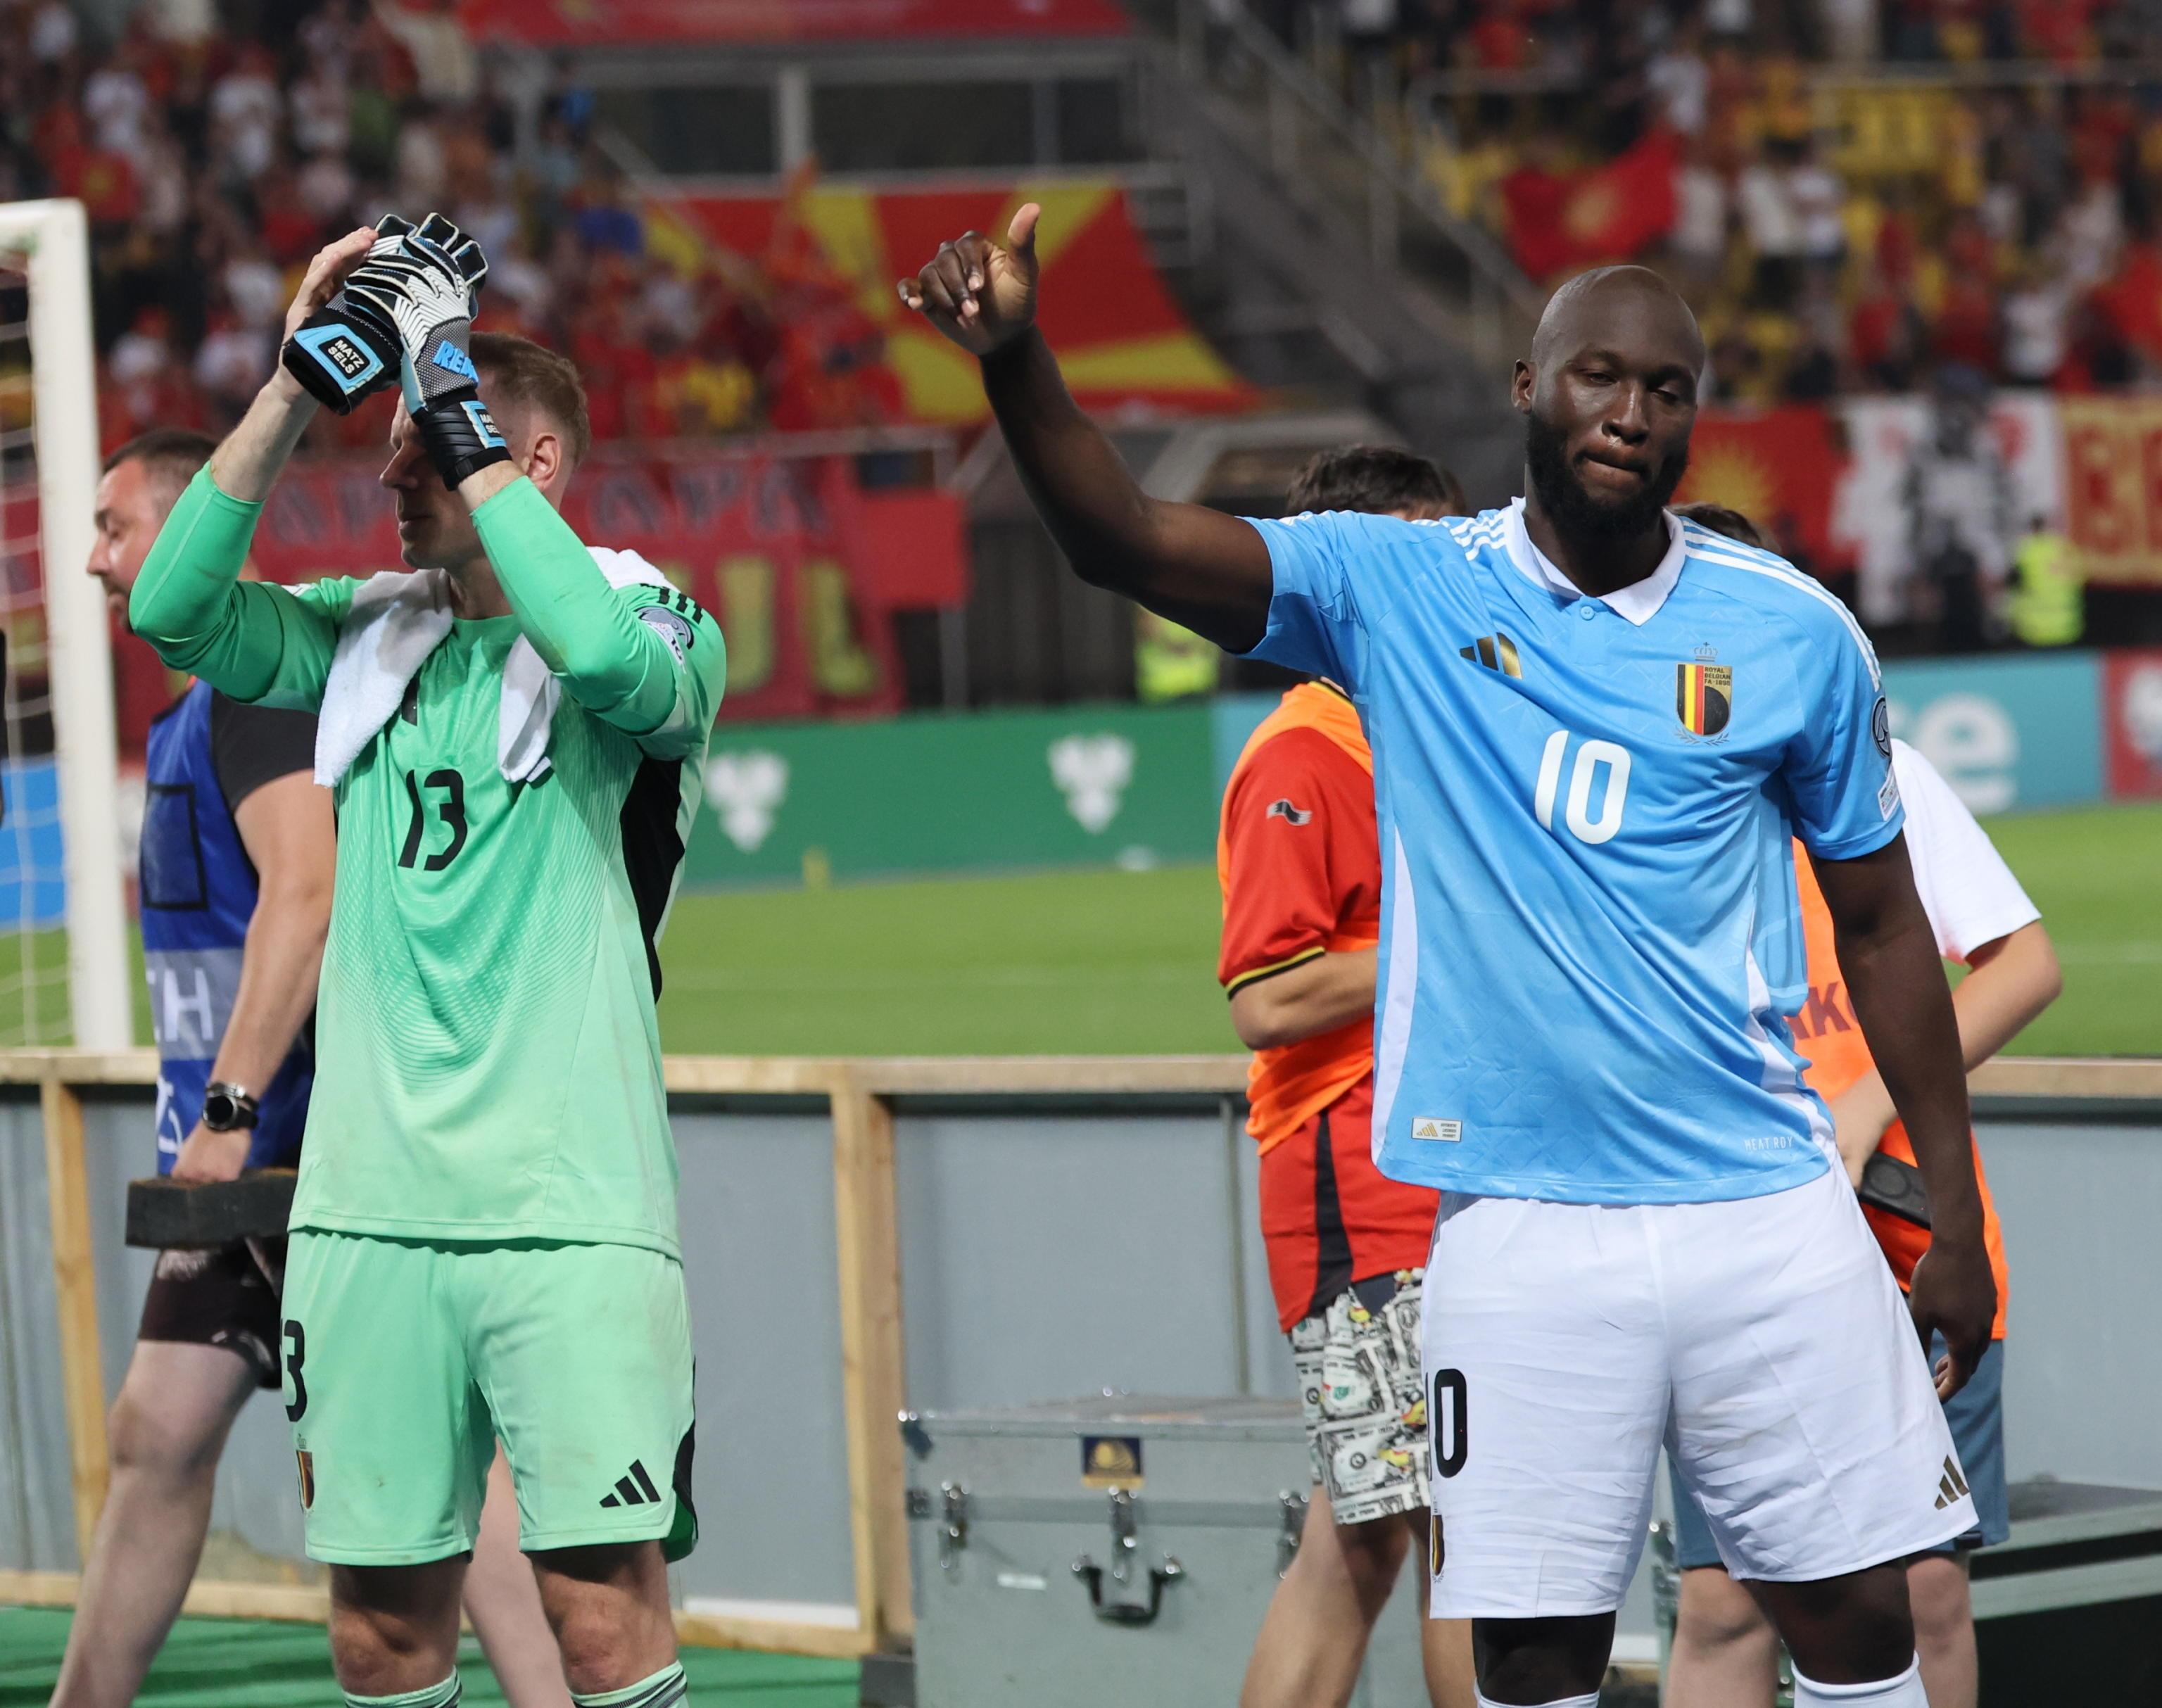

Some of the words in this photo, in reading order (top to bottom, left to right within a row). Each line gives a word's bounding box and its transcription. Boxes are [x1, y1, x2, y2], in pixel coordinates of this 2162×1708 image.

[327, 346, 355, 374] SELS
[334, 339, 365, 368] MATZ
[398, 768, 468, 871] 13
[1534, 730, 1631, 844] 10
